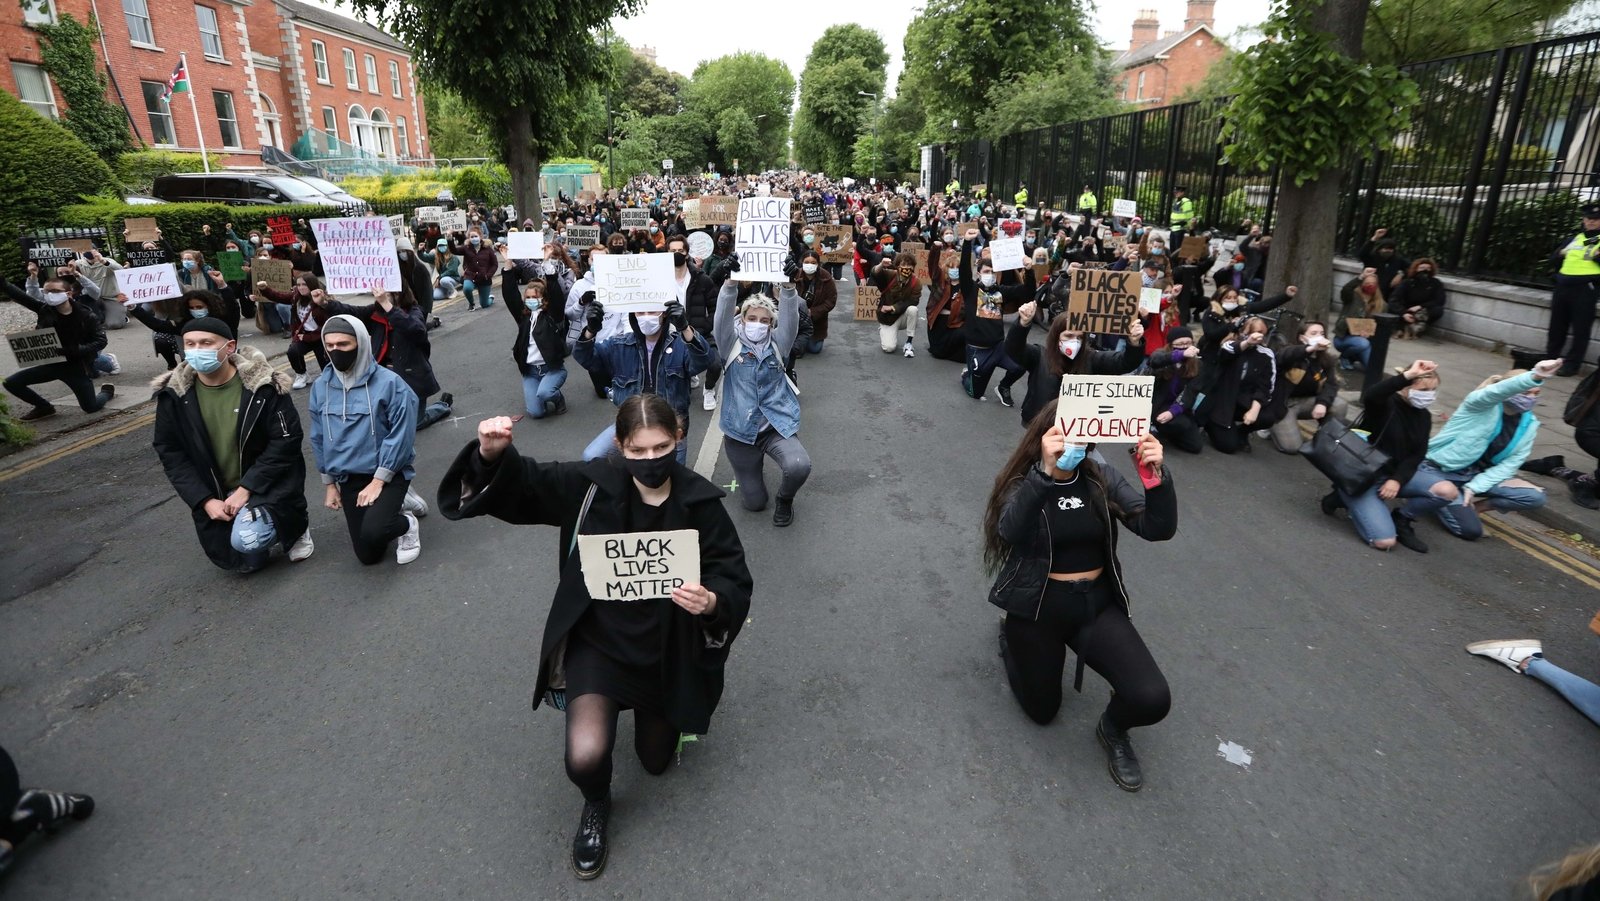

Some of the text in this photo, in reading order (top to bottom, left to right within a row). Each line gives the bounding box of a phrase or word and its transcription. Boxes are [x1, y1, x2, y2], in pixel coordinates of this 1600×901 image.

[712, 204, 726, 212] FOR
[740, 199, 789, 221] BLACK
[440, 211, 458, 219] BLACK
[701, 212, 738, 221] BLACK LIVES
[339, 221, 358, 230] YOU
[365, 220, 383, 230] ARE
[388, 218, 403, 227] RECT
[441, 224, 463, 232] MATTER
[622, 219, 647, 227] PROVISION
[567, 229, 598, 238] END DIRECT
[738, 224, 789, 246] LIVES
[567, 237, 596, 246] PROVISION
[29, 248, 72, 259] BLACK LIVES
[38, 257, 67, 267] MATTER
[617, 257, 647, 269] END
[738, 251, 788, 273] MATTER
[607, 273, 647, 286] DIRECT
[1075, 270, 1130, 293] BLACK
[858, 286, 880, 297] BLAC
[858, 296, 880, 306] LIVE
[1087, 293, 1137, 316] LIVES
[857, 308, 876, 318] MAT
[1069, 312, 1131, 334] MATTER
[9, 332, 58, 351] END DIRECT
[1062, 383, 1152, 398] WHITE SILENCE
[1060, 416, 1147, 438] VIOLENCE
[604, 538, 675, 559] BLACK
[613, 558, 669, 577] LIVES
[606, 578, 685, 598] MATTER
